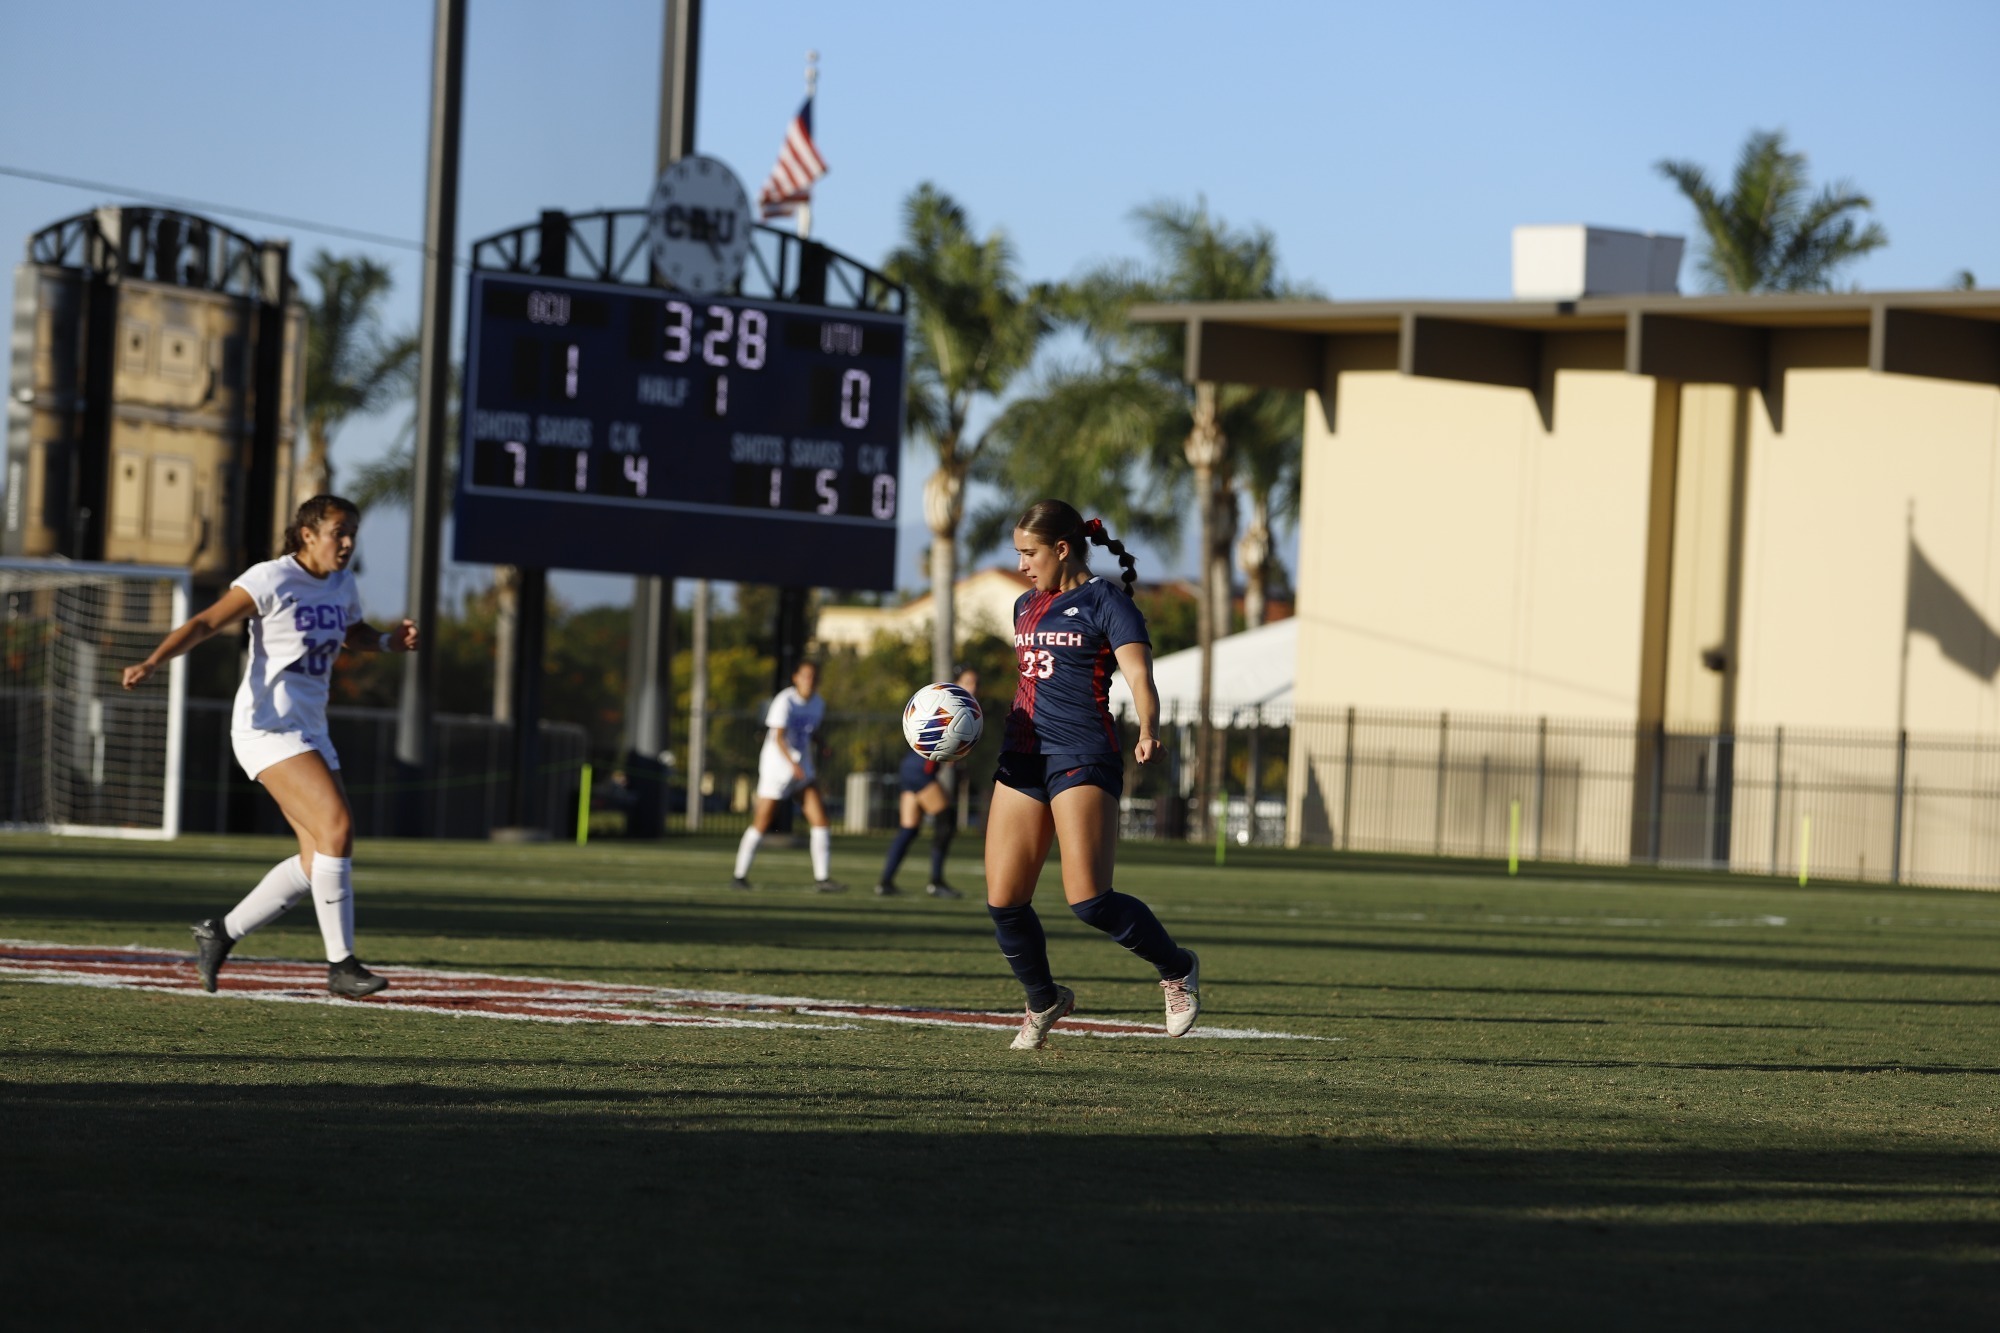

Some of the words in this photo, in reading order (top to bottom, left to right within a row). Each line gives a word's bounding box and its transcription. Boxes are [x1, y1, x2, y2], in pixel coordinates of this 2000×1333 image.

[664, 300, 768, 370] 3:28
[565, 344, 580, 398] 1
[637, 374, 690, 407] HALF
[715, 374, 729, 417] 1
[473, 408, 530, 443] SHOTS
[841, 369, 871, 429] 0
[504, 441, 527, 487] 7
[575, 450, 589, 493] 1
[624, 454, 648, 497] 4
[730, 432, 785, 465] SHOTS
[769, 467, 782, 508] 1
[815, 468, 839, 516] 5
[872, 473, 896, 521] 0
[1014, 632, 1035, 648] TAH
[1037, 631, 1082, 647] TECH
